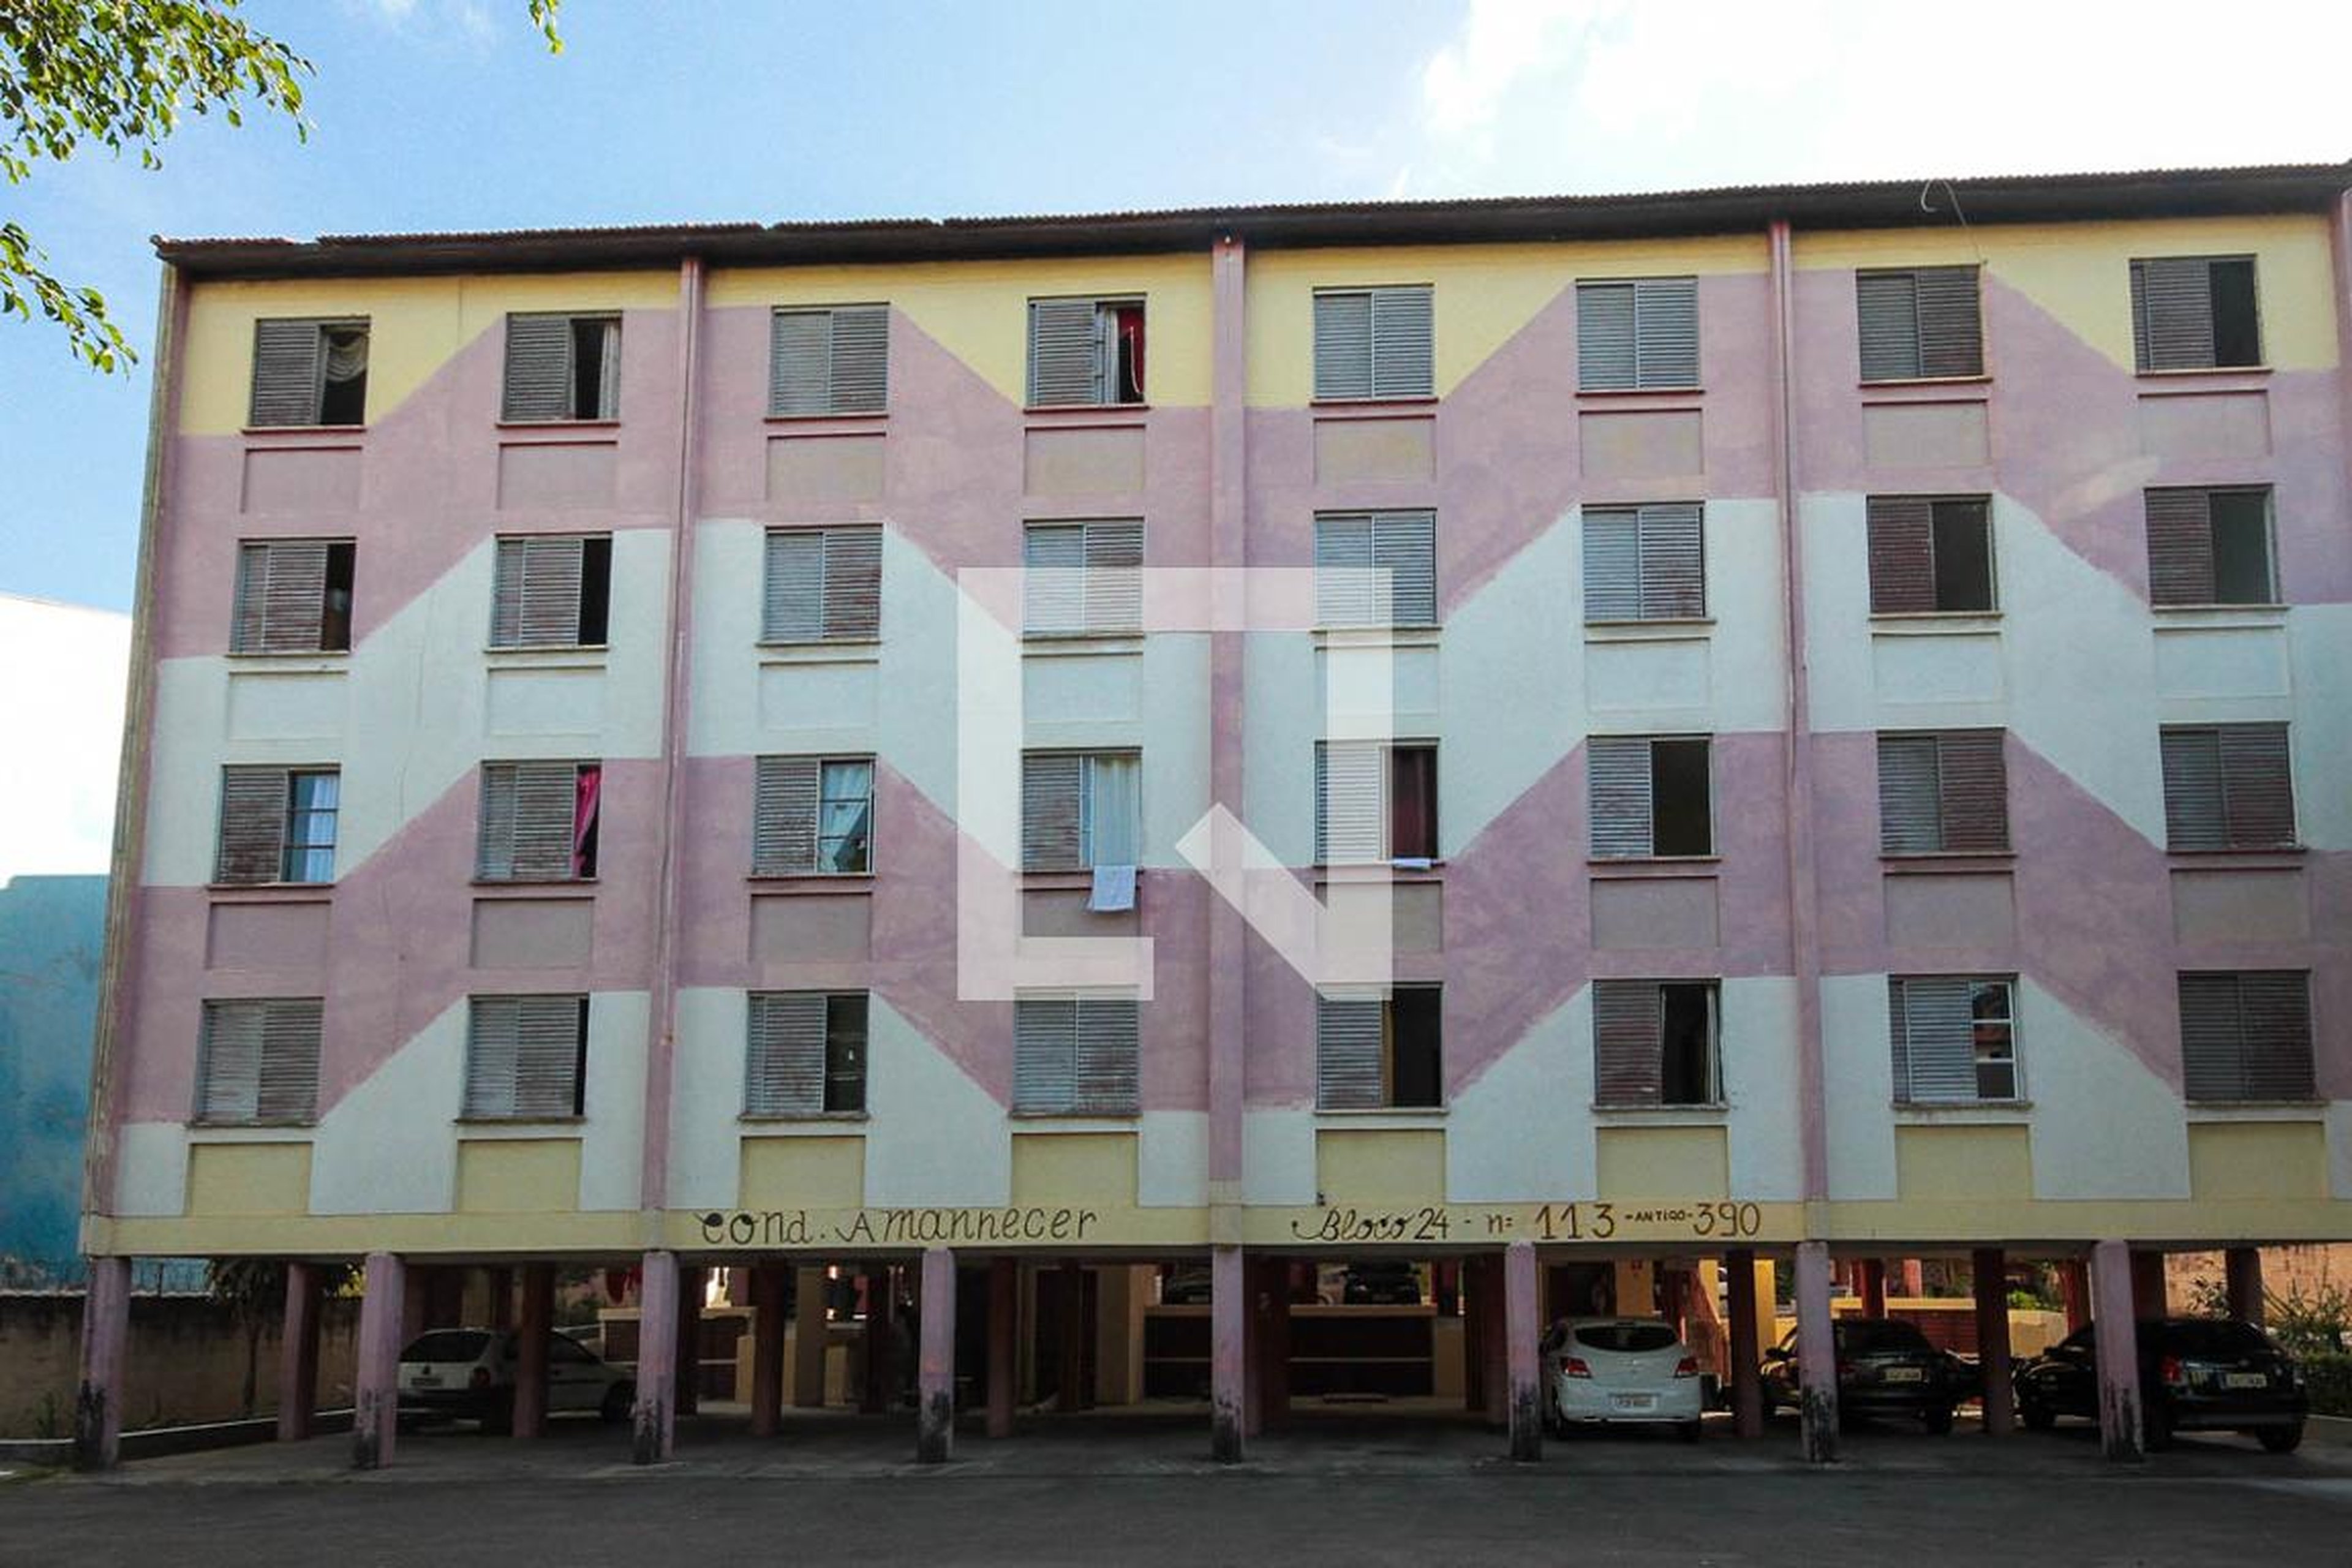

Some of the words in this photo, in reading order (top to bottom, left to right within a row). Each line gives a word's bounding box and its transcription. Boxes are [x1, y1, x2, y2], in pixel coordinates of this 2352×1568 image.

[1291, 1207, 1411, 1241] Bloco
[1414, 1207, 1450, 1240] 24
[1535, 1202, 1615, 1240] 113
[1692, 1202, 1761, 1237] 390
